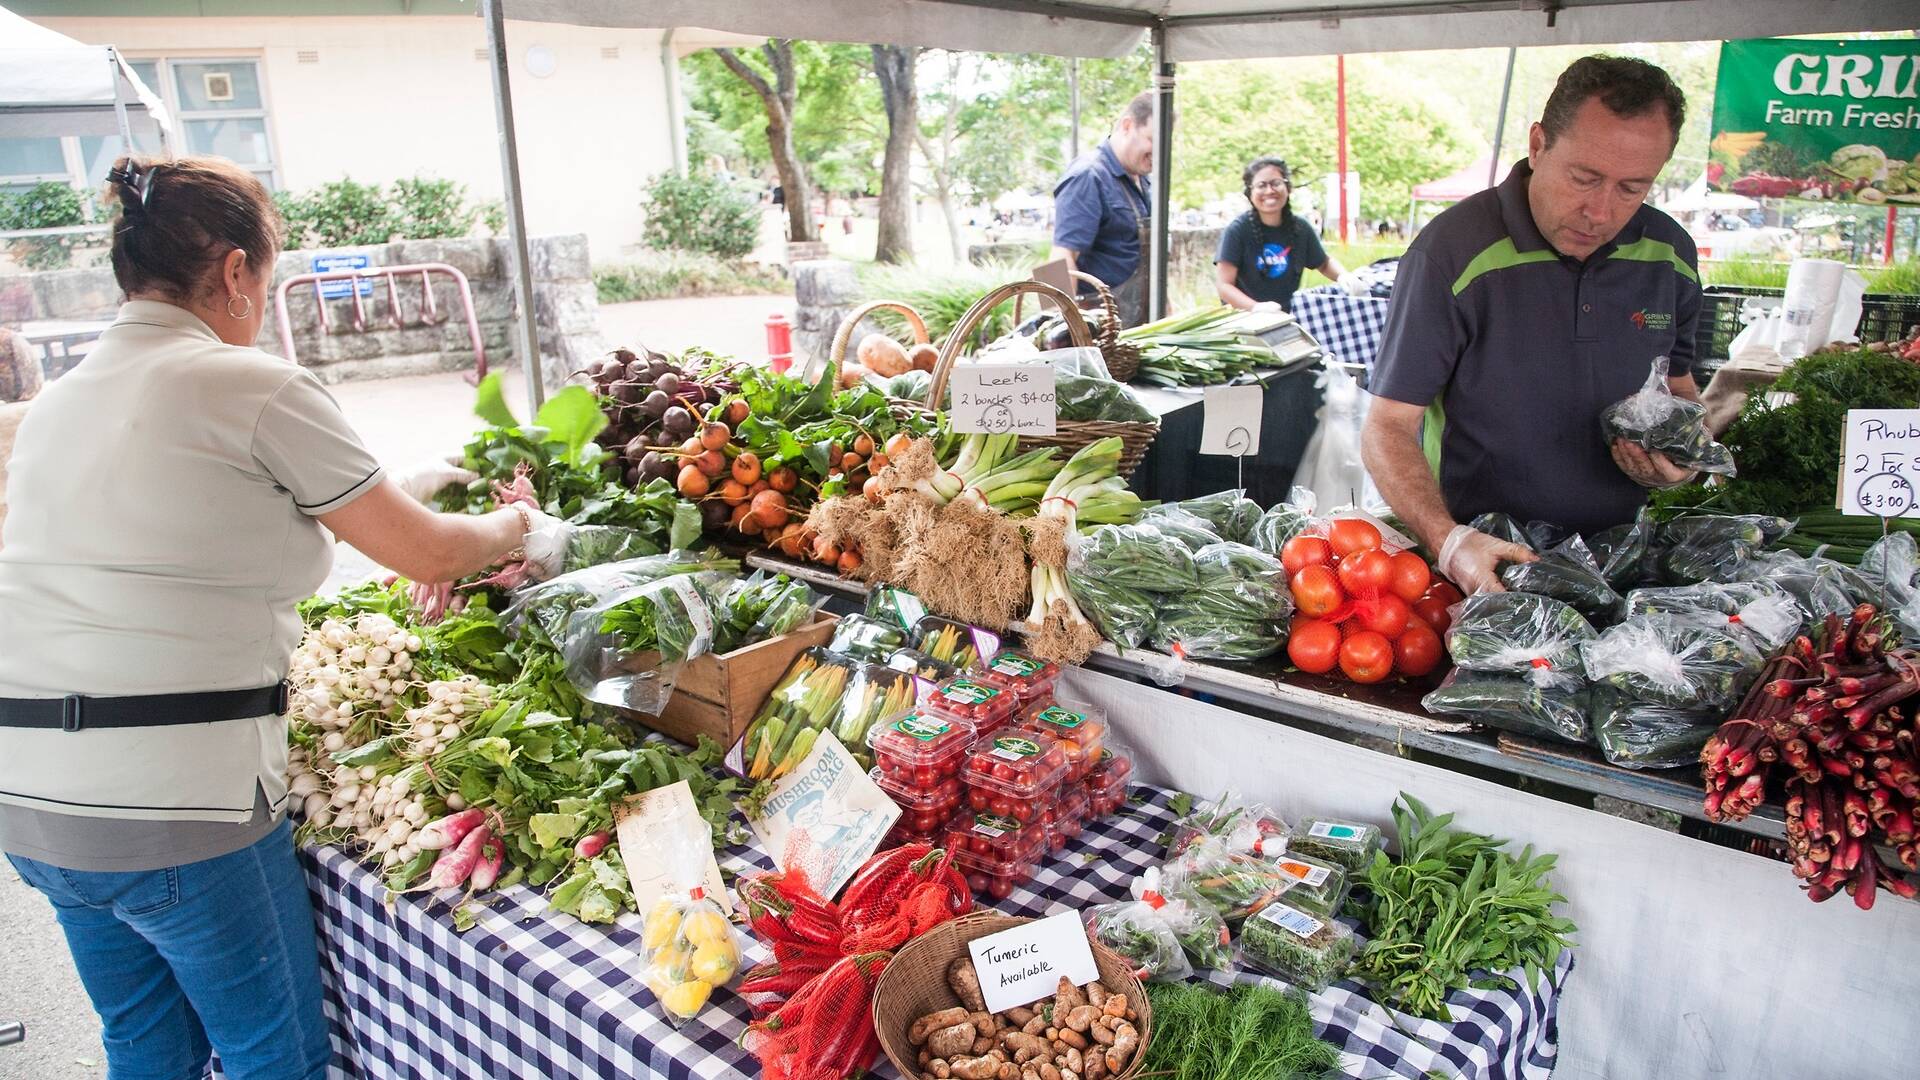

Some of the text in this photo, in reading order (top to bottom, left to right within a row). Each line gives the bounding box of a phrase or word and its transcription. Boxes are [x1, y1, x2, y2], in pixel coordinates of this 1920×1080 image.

[1765, 100, 1920, 130] Farm Fresh
[961, 393, 969, 405] 2
[975, 393, 1013, 406] bunches
[1854, 454, 1869, 473] 2
[1881, 452, 1904, 474] For
[762, 746, 837, 820] MUSHROOM
[820, 756, 845, 791] BAG
[981, 943, 1039, 965] Tumeric
[1000, 961, 1053, 988] Available
